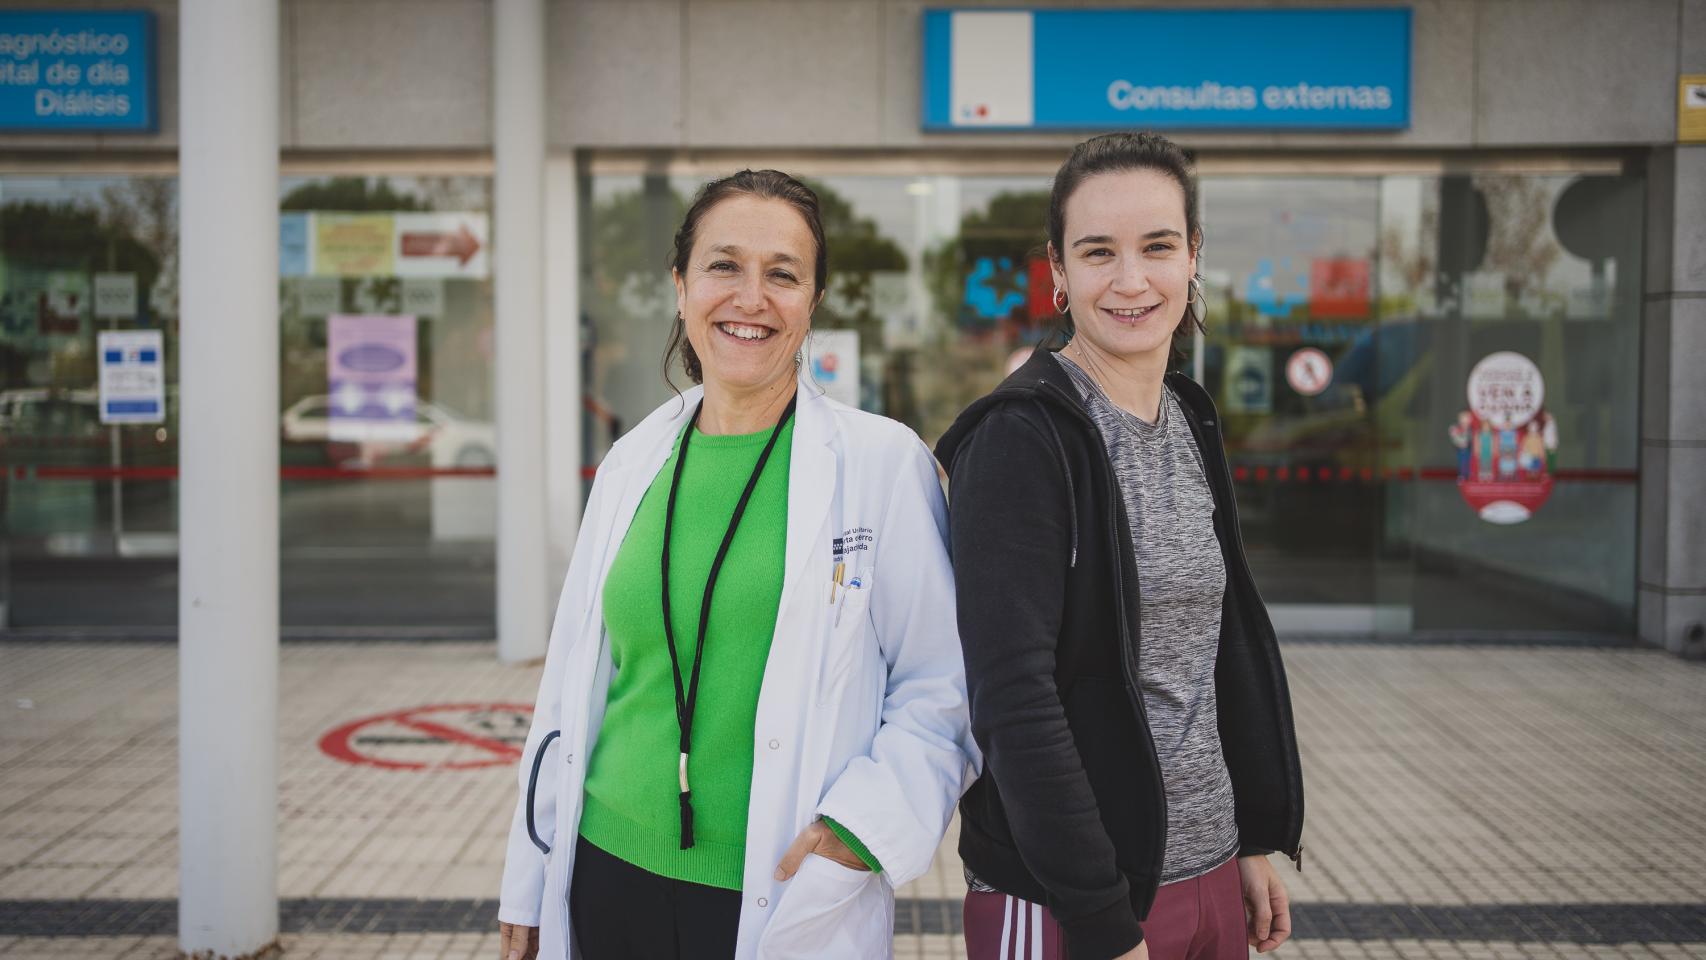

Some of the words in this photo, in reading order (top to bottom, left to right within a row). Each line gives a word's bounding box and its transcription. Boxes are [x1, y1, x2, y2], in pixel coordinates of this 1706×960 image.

[46, 59, 81, 86] de
[34, 88, 131, 117] Diálisis
[1106, 79, 1258, 110] Consultas
[1262, 81, 1393, 110] externas
